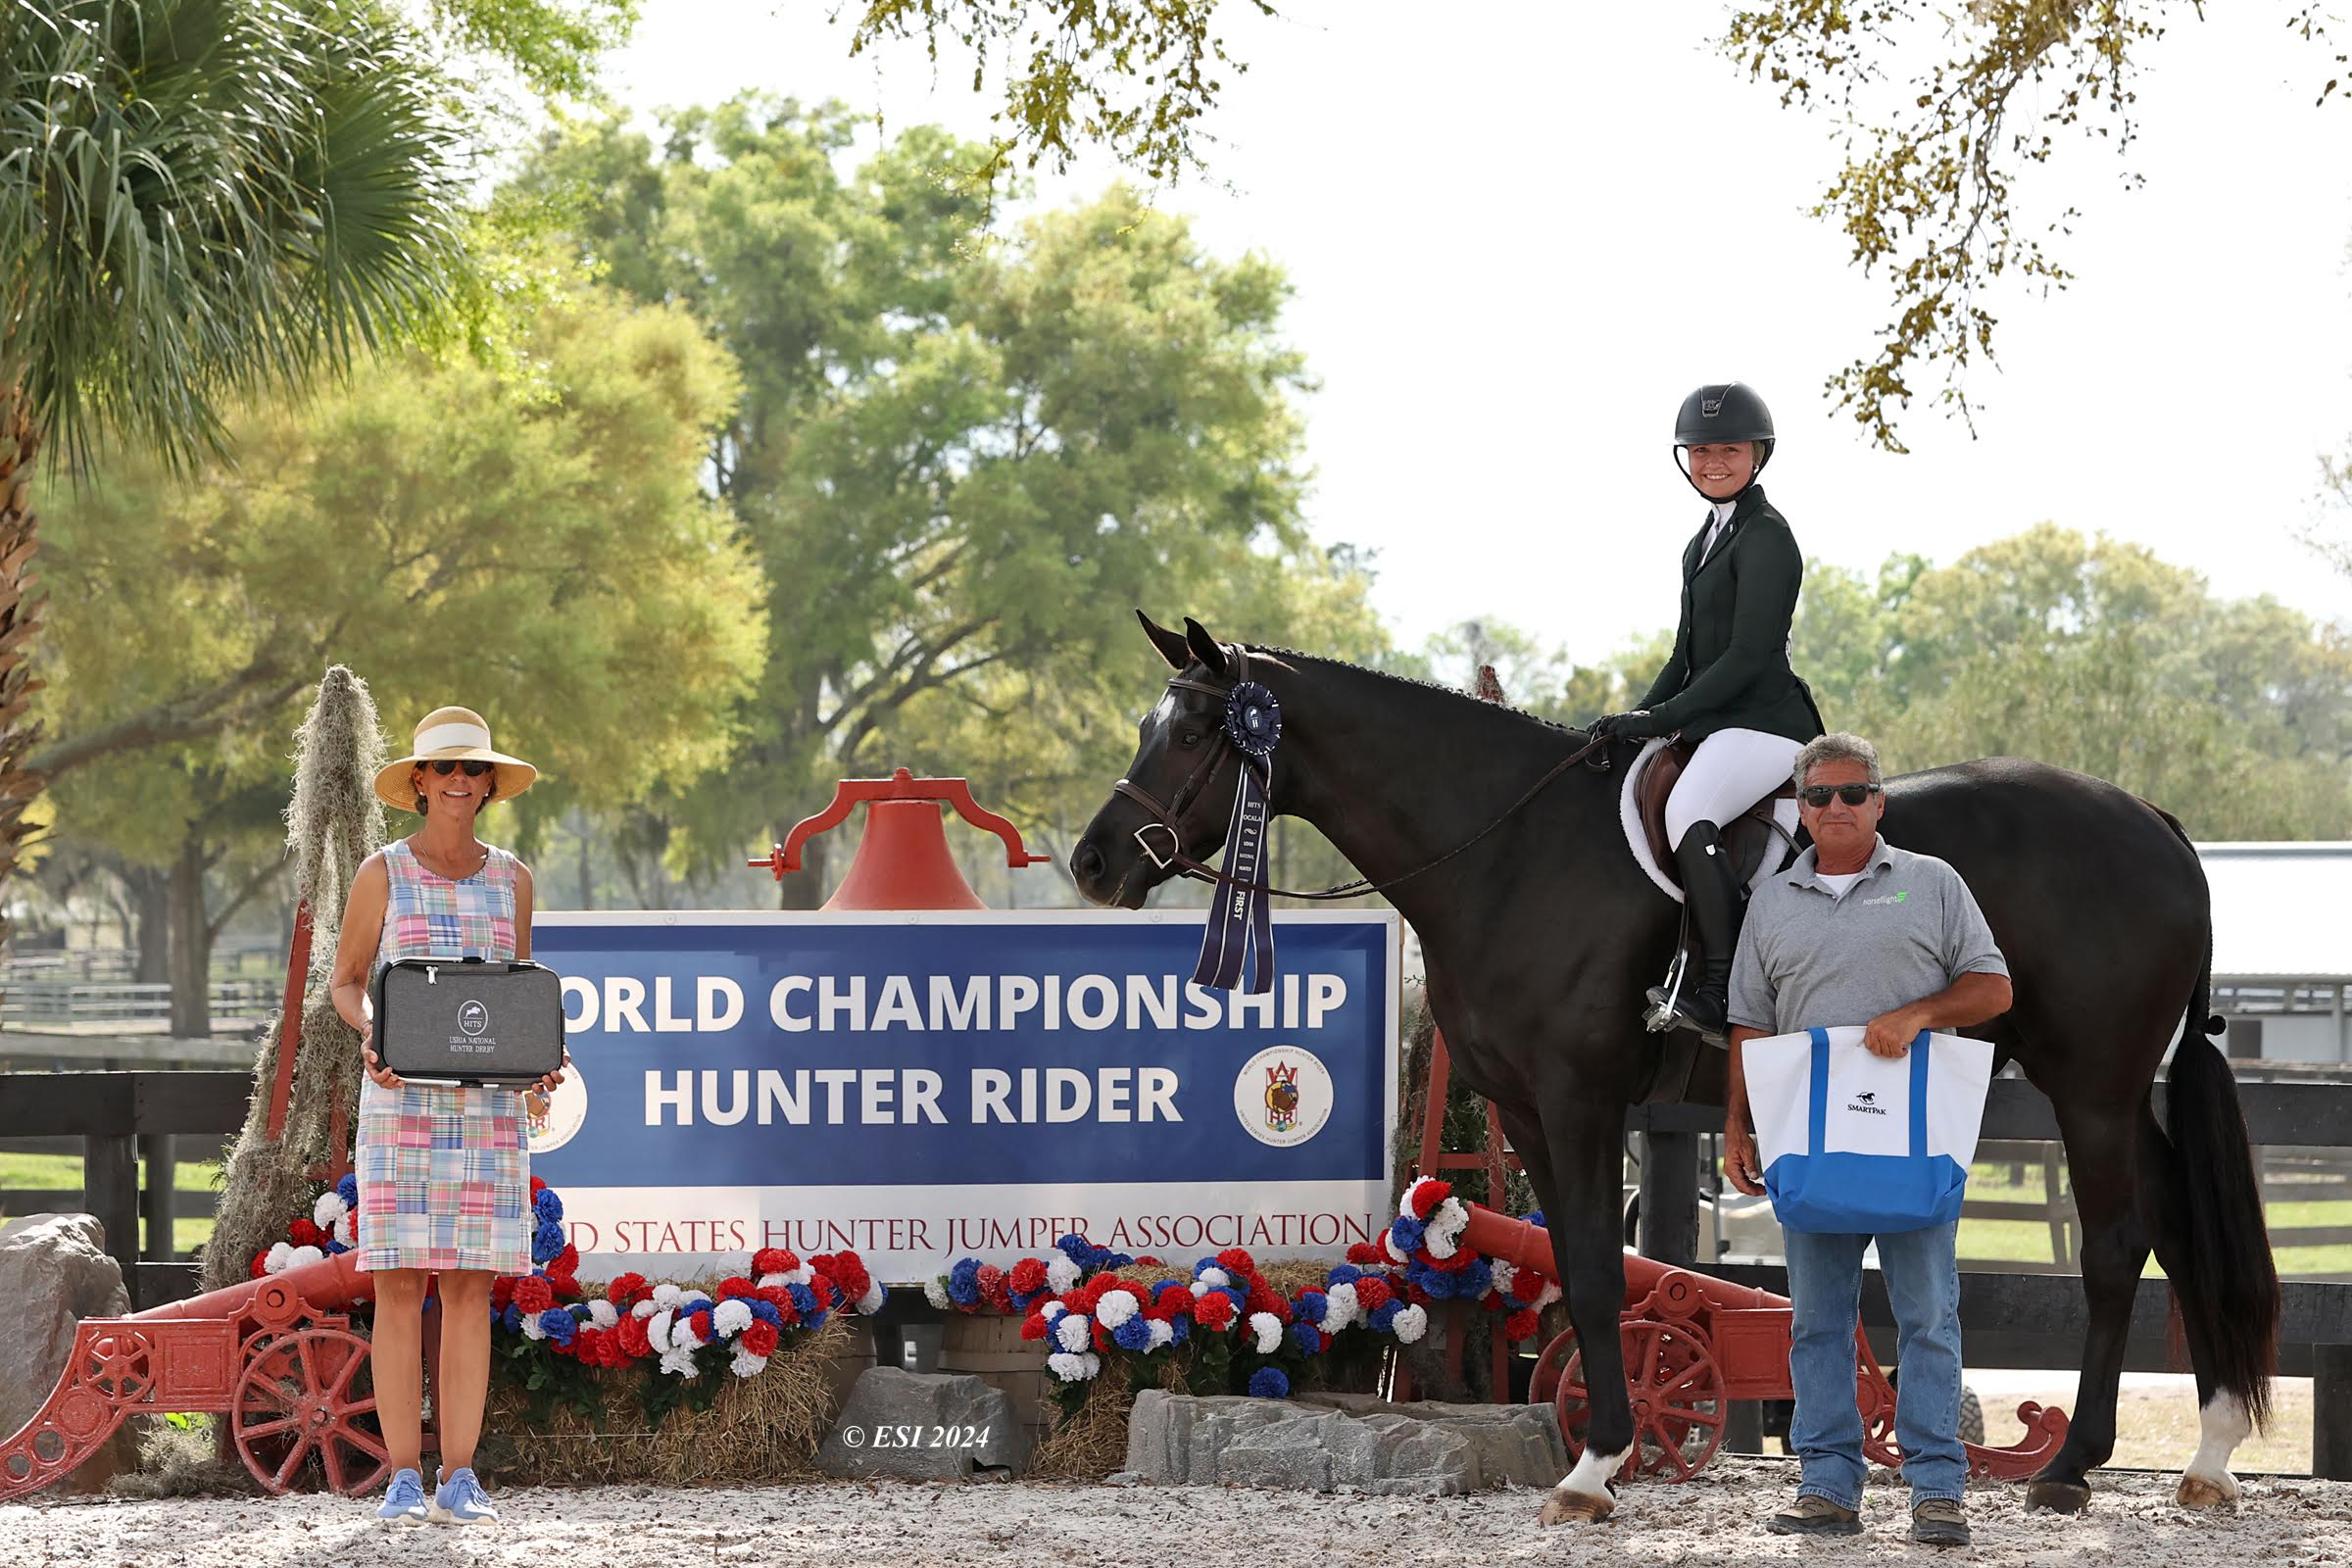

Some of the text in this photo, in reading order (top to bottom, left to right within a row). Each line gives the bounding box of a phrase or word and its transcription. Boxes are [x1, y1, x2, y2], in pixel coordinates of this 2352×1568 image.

[1233, 890, 1247, 921] FIRST
[561, 973, 1348, 1033] ORLD CHAMPIONSHIP
[467, 1036, 497, 1045] NATIONAL
[474, 1045, 496, 1054] DERBY
[645, 1066, 1184, 1126] HUNTER RIDER
[614, 1220, 746, 1252] STATES
[761, 1218, 937, 1251] HUNTER
[943, 1215, 1092, 1258] JUMPER
[1107, 1213, 1372, 1249] ASSOCIATION
